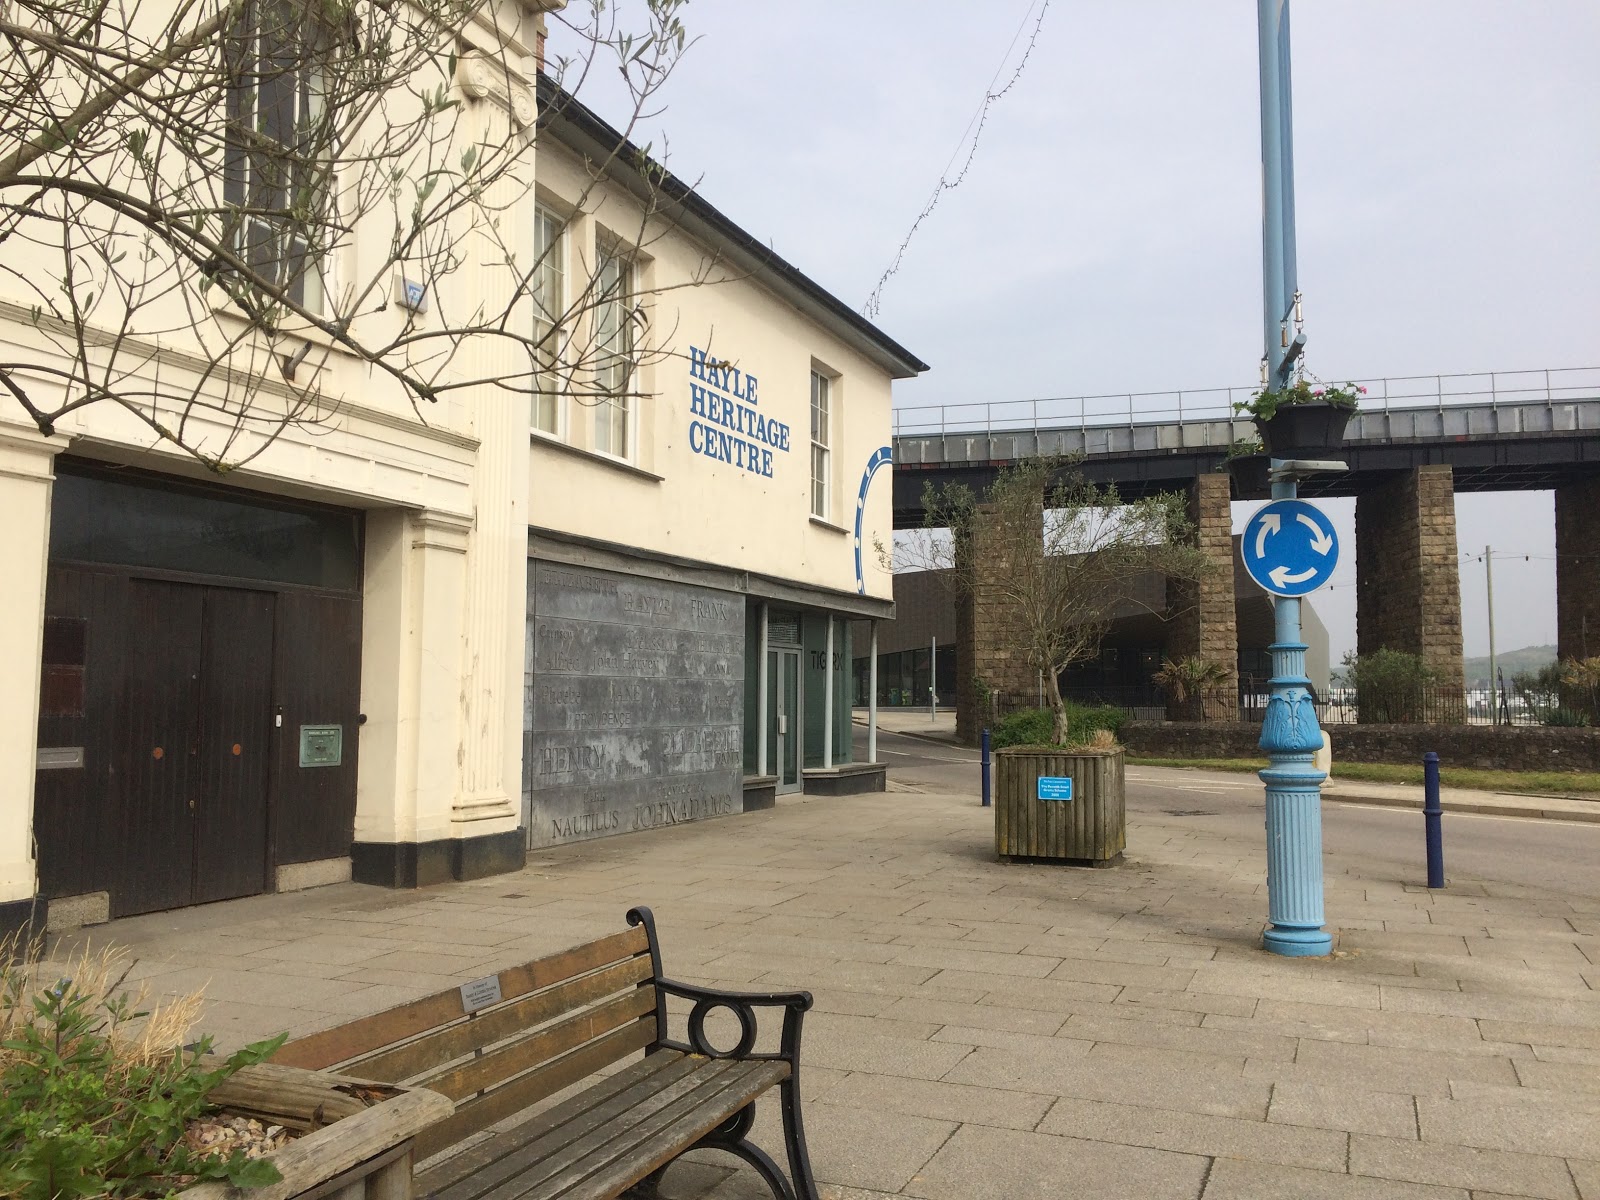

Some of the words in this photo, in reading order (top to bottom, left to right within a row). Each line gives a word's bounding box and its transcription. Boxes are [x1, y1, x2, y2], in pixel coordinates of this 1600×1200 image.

[689, 345, 758, 406] HAYLE
[689, 382, 790, 453] HERITAGE
[689, 420, 773, 478] CENTRE
[690, 598, 727, 621] FRANK
[622, 652, 660, 675] Harvey
[810, 650, 844, 671] TIGRX
[575, 711, 631, 728] PROVIDENCE
[539, 744, 607, 775] HENRY
[551, 810, 619, 839] NAUTILUS
[632, 800, 676, 830] JOHN
[677, 794, 732, 823] ADAMS
